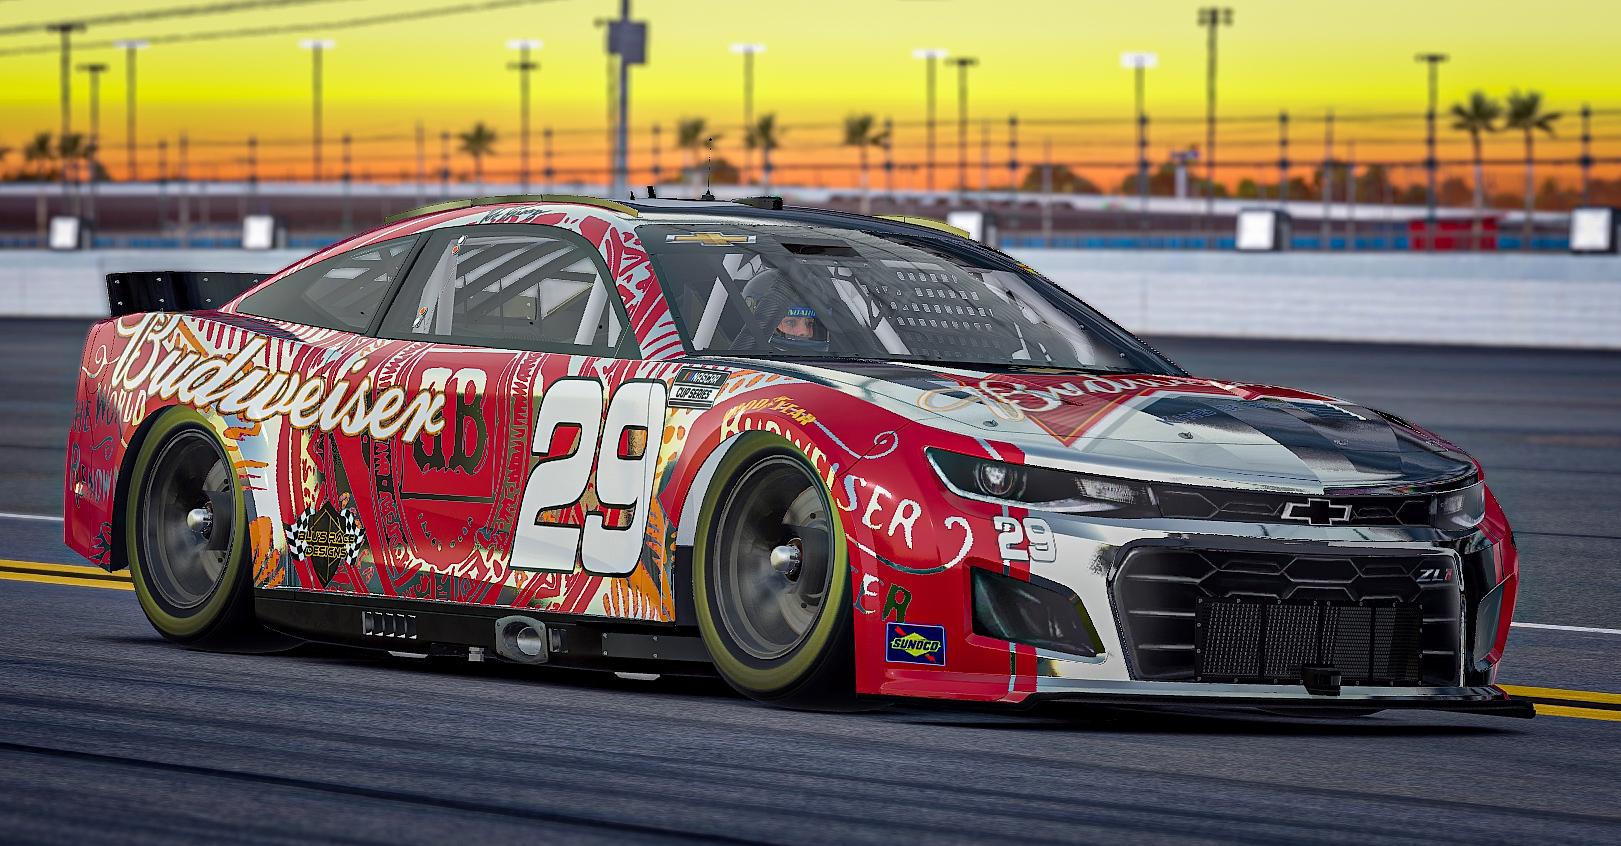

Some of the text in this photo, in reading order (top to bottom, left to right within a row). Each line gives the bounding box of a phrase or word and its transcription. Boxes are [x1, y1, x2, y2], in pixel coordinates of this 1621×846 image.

[113, 312, 446, 443] Budweiser
[693, 371, 721, 384] NASCAR
[676, 387, 713, 400] CUP SERIES
[96, 382, 147, 448] WORLD
[508, 376, 668, 579] 29
[297, 530, 356, 544] BLU'S RACE
[993, 515, 1057, 563] 29
[304, 545, 348, 559] DESIGNS
[891, 637, 941, 653] SUNOCO
